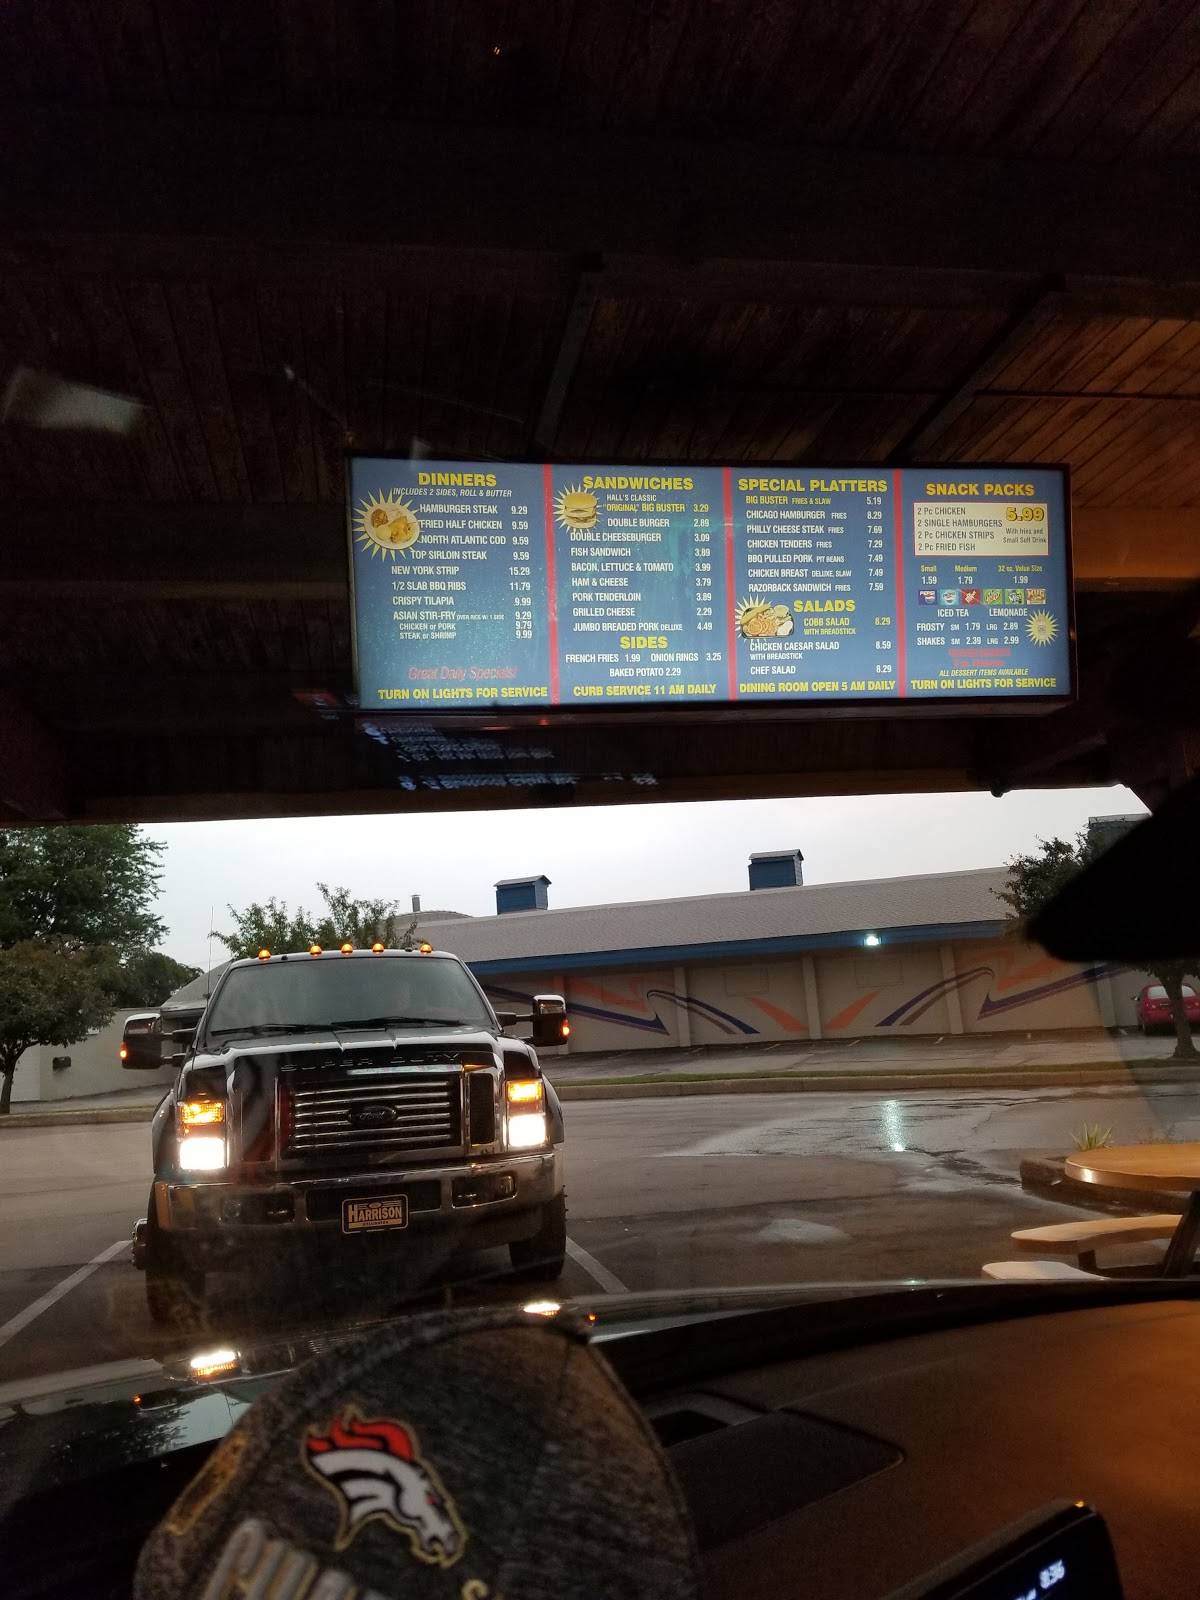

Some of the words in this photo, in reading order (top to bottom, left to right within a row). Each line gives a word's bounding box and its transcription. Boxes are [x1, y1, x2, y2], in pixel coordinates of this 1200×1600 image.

[418, 473, 496, 487] DINNERS
[583, 476, 693, 490] SANDWICHES
[738, 479, 805, 491] SPECIAL
[810, 480, 888, 492] PLATTERS
[926, 483, 979, 496] SNACK
[984, 483, 1035, 496] PACKS
[393, 488, 428, 496] INCLUDES
[746, 496, 758, 504] BIG
[760, 496, 788, 504] BUSTER
[867, 497, 881, 505] 5.19
[420, 504, 471, 514] HAMBURGER
[473, 505, 498, 514] STEAK
[511, 506, 527, 515] 9.29
[656, 504, 685, 512] BUSTER
[746, 511, 778, 519] CHICAGO
[780, 511, 825, 519] HAMBURGER
[1006, 506, 1044, 521] 5.99
[421, 520, 444, 528] FRIED
[446, 520, 466, 529] HALF
[468, 521, 502, 529] CHICKEN
[511, 521, 528, 530] 9.59
[639, 519, 669, 527] BURGER
[747, 526, 771, 534] PHILLY
[570, 533, 600, 541] DOUBLE
[602, 533, 661, 541] CHEESEBURGER
[918, 531, 922, 539] 2
[935, 531, 967, 539] CHICKEN
[422, 536, 449, 544] NORTH
[451, 536, 487, 544] ATLANTIC
[489, 536, 506, 545] COD
[512, 536, 528, 545] 9.59
[748, 540, 778, 548] CHICKEN
[780, 540, 812, 548] TENDERS
[868, 540, 882, 548] 7.29
[411, 551, 427, 559] TOP
[429, 551, 460, 559] SIRLOIN
[462, 552, 487, 560] STEAK
[513, 552, 529, 560] 9.59
[571, 548, 588, 556] FISH
[590, 548, 631, 556] SANDWICH
[748, 555, 762, 563] BBQ
[392, 566, 411, 574] NEW
[436, 567, 459, 575] STRIP
[509, 567, 530, 576] 15.29
[571, 563, 599, 572] BACON,
[601, 563, 635, 571] LETTUCE
[748, 569, 779, 578] CHICKEN
[781, 569, 807, 577] BREAST
[392, 582, 405, 590] 1/2
[407, 582, 428, 590] SLAB
[429, 582, 448, 590] BBQ
[450, 582, 466, 590] RIBS
[510, 582, 530, 591] 11.79
[572, 578, 590, 586] HAM
[592, 578, 598, 586] &
[600, 578, 628, 586] CHEESE
[696, 578, 711, 586] 3.79
[749, 584, 791, 592] RAZORBACK
[793, 583, 831, 591] SANDWICH
[393, 597, 422, 605] CRISPY
[424, 597, 454, 605] TILAPIA
[595, 593, 641, 601] TENDERLOIN
[794, 600, 856, 612] SALADS
[394, 612, 418, 620] ASIAN
[420, 612, 456, 620] STIR-FRY
[515, 611, 531, 620] 9.29
[573, 608, 605, 616] GRILLED
[607, 608, 635, 616] CHEESE
[938, 609, 954, 617] ICED
[956, 609, 969, 617] TEA
[989, 608, 1028, 616] LEMONADE
[516, 621, 532, 629] 9.79
[804, 618, 823, 626] COBB
[826, 618, 850, 626] SALAD
[573, 623, 600, 631] JUMBO
[602, 623, 636, 631] BREADED
[917, 623, 945, 631] FROSTY
[516, 630, 532, 639] 9.99
[620, 636, 668, 649] SIDES
[917, 637, 945, 645] SHAKES
[750, 642, 782, 651] CHICKEN
[785, 642, 813, 650] CAESAR
[815, 641, 839, 650] SALAD
[566, 654, 596, 663] FRENCH
[598, 654, 619, 662] FRIES
[625, 654, 640, 662] 1.99
[651, 653, 674, 662] ONION
[676, 653, 698, 661] RINGS
[706, 653, 721, 661] 3.25
[750, 653, 766, 661] WITH
[610, 668, 634, 676] BAKED
[636, 668, 663, 676] POTATO
[666, 668, 681, 676] 2.29
[751, 666, 769, 674] CHEF
[771, 666, 796, 674] SALAD
[740, 683, 775, 693] DINING
[779, 682, 808, 692] ROOM
[811, 682, 838, 691] OPEN
[842, 682, 848, 690] 5
[850, 682, 866, 691] AM
[868, 680, 895, 690] DAILY
[911, 680, 937, 689] TURN
[941, 680, 955, 689] ON
[957, 680, 991, 688] LIGHTS
[994, 679, 1014, 688] FOR
[1016, 678, 1056, 688] SERVICE
[378, 689, 409, 700] TURN
[413, 688, 429, 699] ON
[433, 688, 473, 699] LIGHTS
[477, 688, 498, 698] FOR
[501, 687, 547, 698] SERVICE
[574, 686, 603, 696] CURB
[606, 685, 651, 696] SERVICE
[654, 686, 664, 695] 11
[669, 685, 684, 694] AM
[688, 684, 717, 694] DAILY
[348, 1203, 402, 1222] HARRISON
